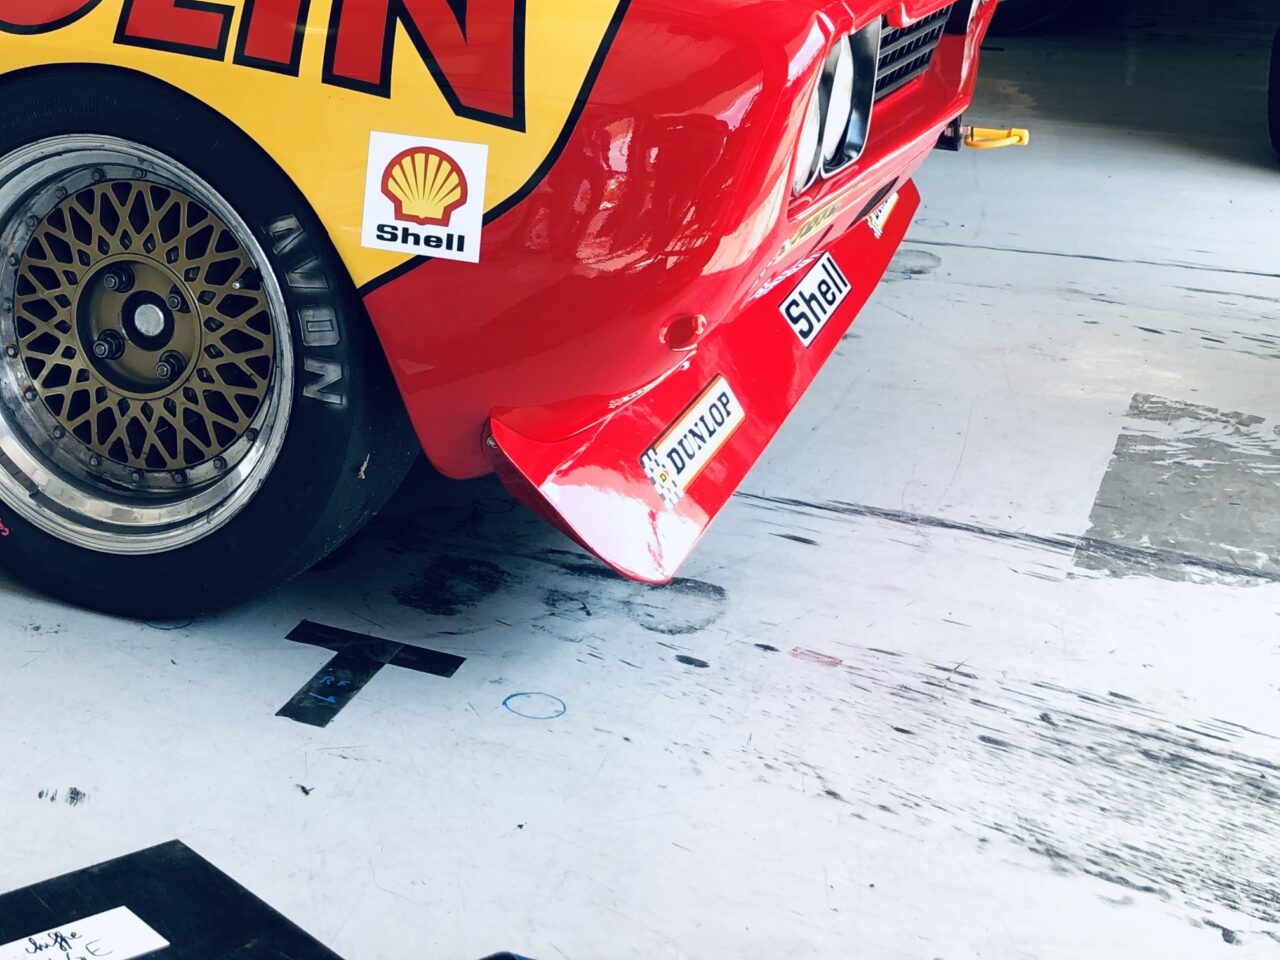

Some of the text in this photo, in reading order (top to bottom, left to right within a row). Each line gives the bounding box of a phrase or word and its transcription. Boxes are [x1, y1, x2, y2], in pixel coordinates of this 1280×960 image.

[375, 223, 465, 252] Shell
[269, 214, 343, 405] AVON
[784, 256, 849, 339] Shell
[666, 391, 732, 475] DUNLOP
